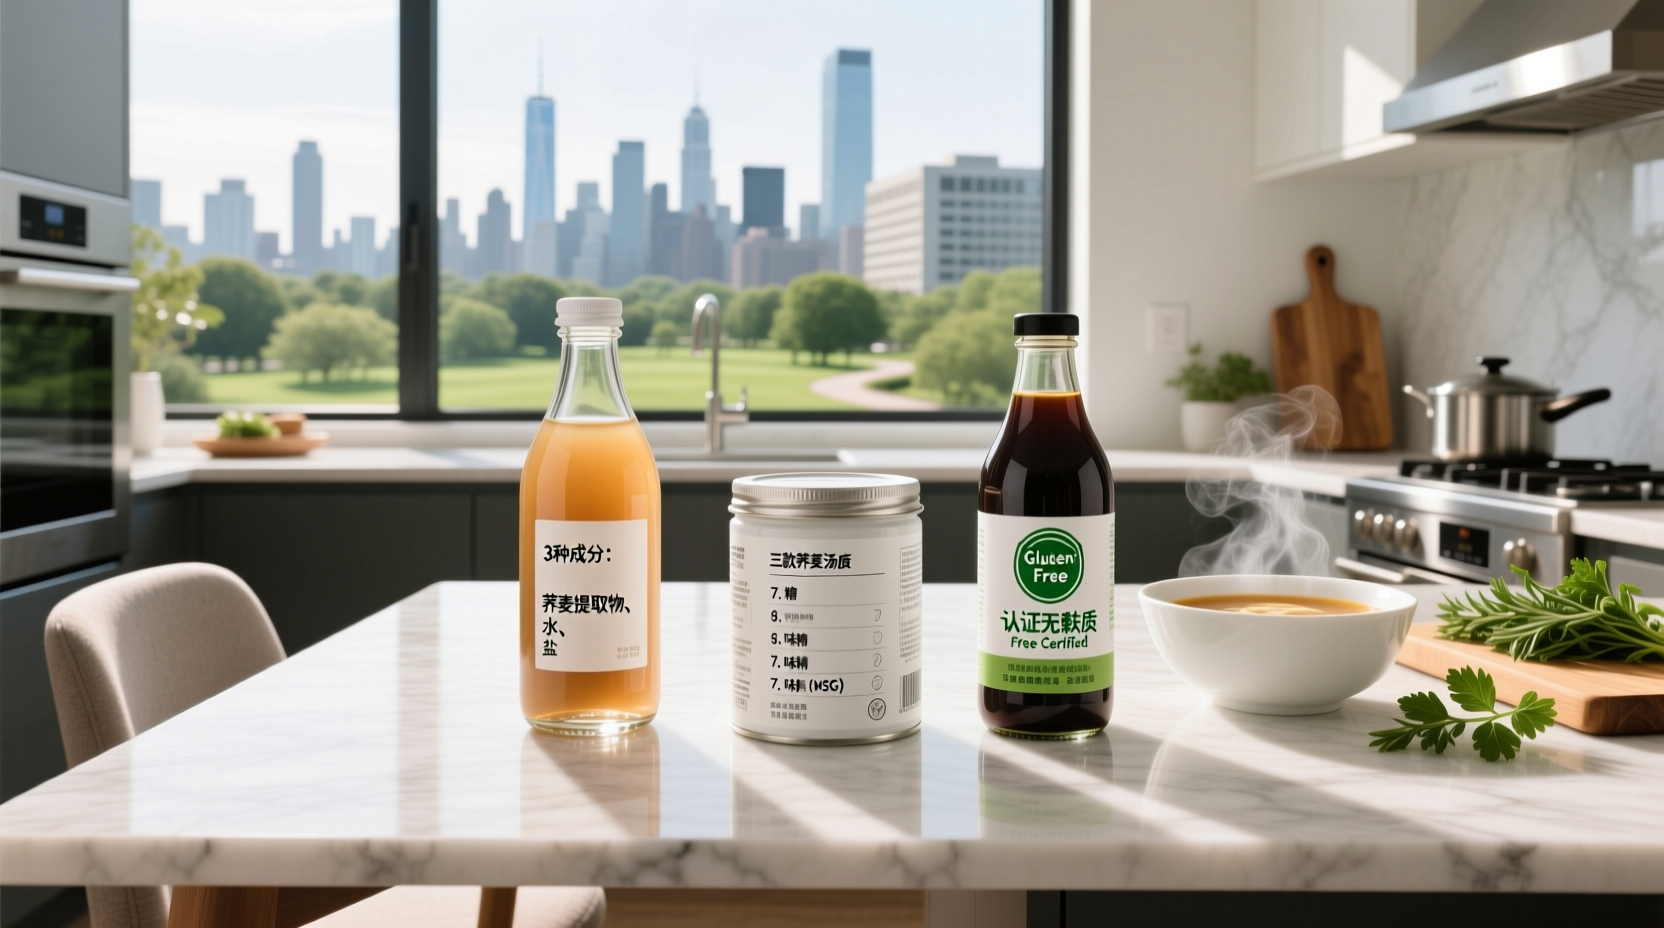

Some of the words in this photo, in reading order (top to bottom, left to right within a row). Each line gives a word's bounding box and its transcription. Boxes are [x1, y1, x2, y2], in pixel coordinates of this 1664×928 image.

[1033, 568, 1068, 583] Free
[542, 639, 558, 657] 盐
[1011, 636, 1038, 649] Free
